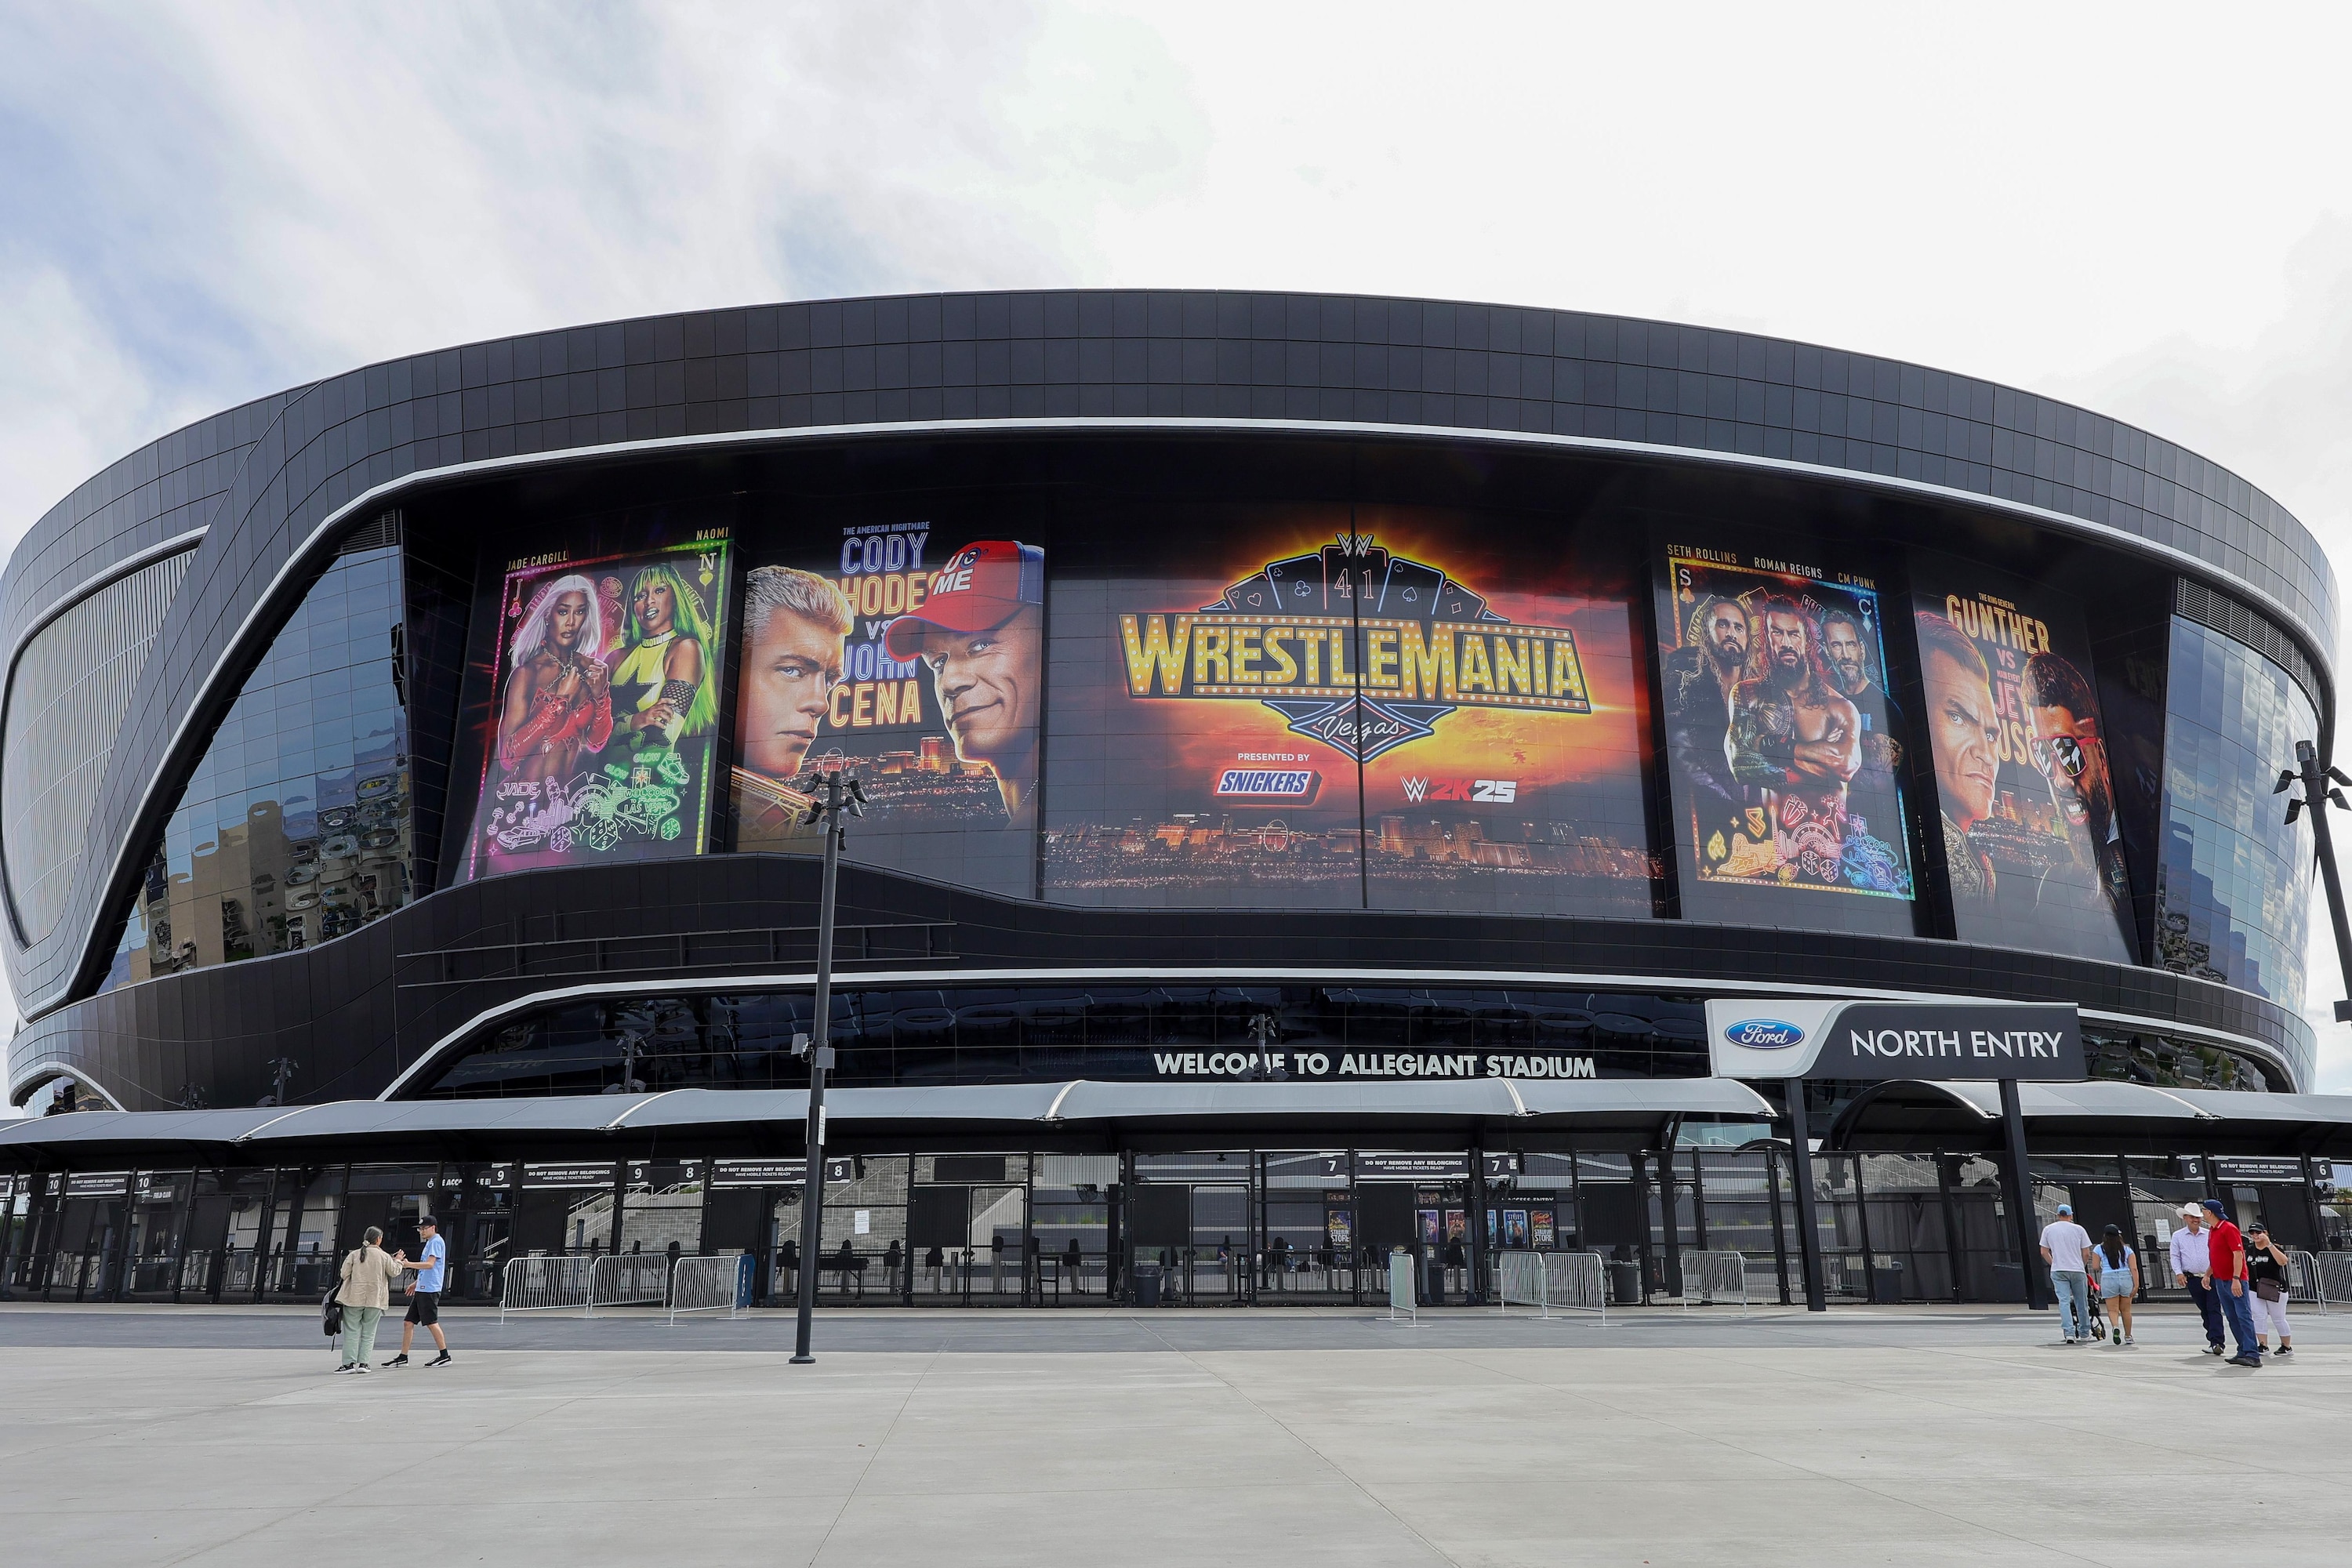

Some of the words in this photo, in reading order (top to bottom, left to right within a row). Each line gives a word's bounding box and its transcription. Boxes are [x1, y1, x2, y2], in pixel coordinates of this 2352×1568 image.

[696, 527, 729, 541] NAOMI
[843, 526, 856, 535] THE
[857, 524, 890, 534] AMERICAN
[891, 521, 930, 532] NIGHTMARE
[506, 560, 528, 572] JADE
[530, 550, 568, 568] CARGILL
[698, 552, 717, 572] N
[841, 532, 929, 574] CODY
[1667, 544, 1692, 558] SETH
[1695, 547, 1737, 564] ROLLINS
[1679, 568, 1693, 586] S
[1754, 557, 1787, 573] ROMAN
[1790, 563, 1823, 579] REIGNS
[514, 578, 524, 601] J
[933, 568, 974, 596] ME
[1334, 568, 1374, 599] 41
[1837, 572, 1850, 585] CM
[1853, 575, 1876, 590] PUNK
[826, 572, 940, 617] HODE
[1858, 598, 1872, 615] C
[1946, 594, 2052, 655] GUNTHER
[1996, 648, 2016, 669] VS
[829, 680, 921, 728] CENA
[1318, 716, 1399, 745] Vegas
[633, 753, 661, 764] GLOW
[1237, 753, 1294, 761] PRESENTED
[604, 763, 629, 780] GLOW
[1220, 771, 1308, 793] SNICKERS
[496, 782, 541, 801] JADE
[626, 787, 673, 797] WELCOME
[1431, 779, 1517, 804] 2K25
[624, 804, 642, 815] LAS
[1740, 1023, 1790, 1046] Ford
[1849, 1029, 1960, 1057] NORTH
[1971, 1031, 2063, 1058] ENTRY
[1294, 1053, 1330, 1075] TO
[1338, 1053, 1477, 1076] ALLEGIANT
[1486, 1055, 1596, 1078] STADIUM
[634, 1168, 643, 1179] 9
[685, 1167, 694, 1178] 8
[834, 1165, 843, 1176] 8
[1328, 1160, 1337, 1172] 7
[1491, 1160, 1501, 1172] 7
[2189, 1162, 2198, 1174] 6
[2319, 1164, 2327, 1176] 6
[49, 1179, 59, 1189] 10
[139, 1178, 149, 1188] 10
[497, 1170, 505, 1181] 9
[18, 1181, 27, 1191] 11
